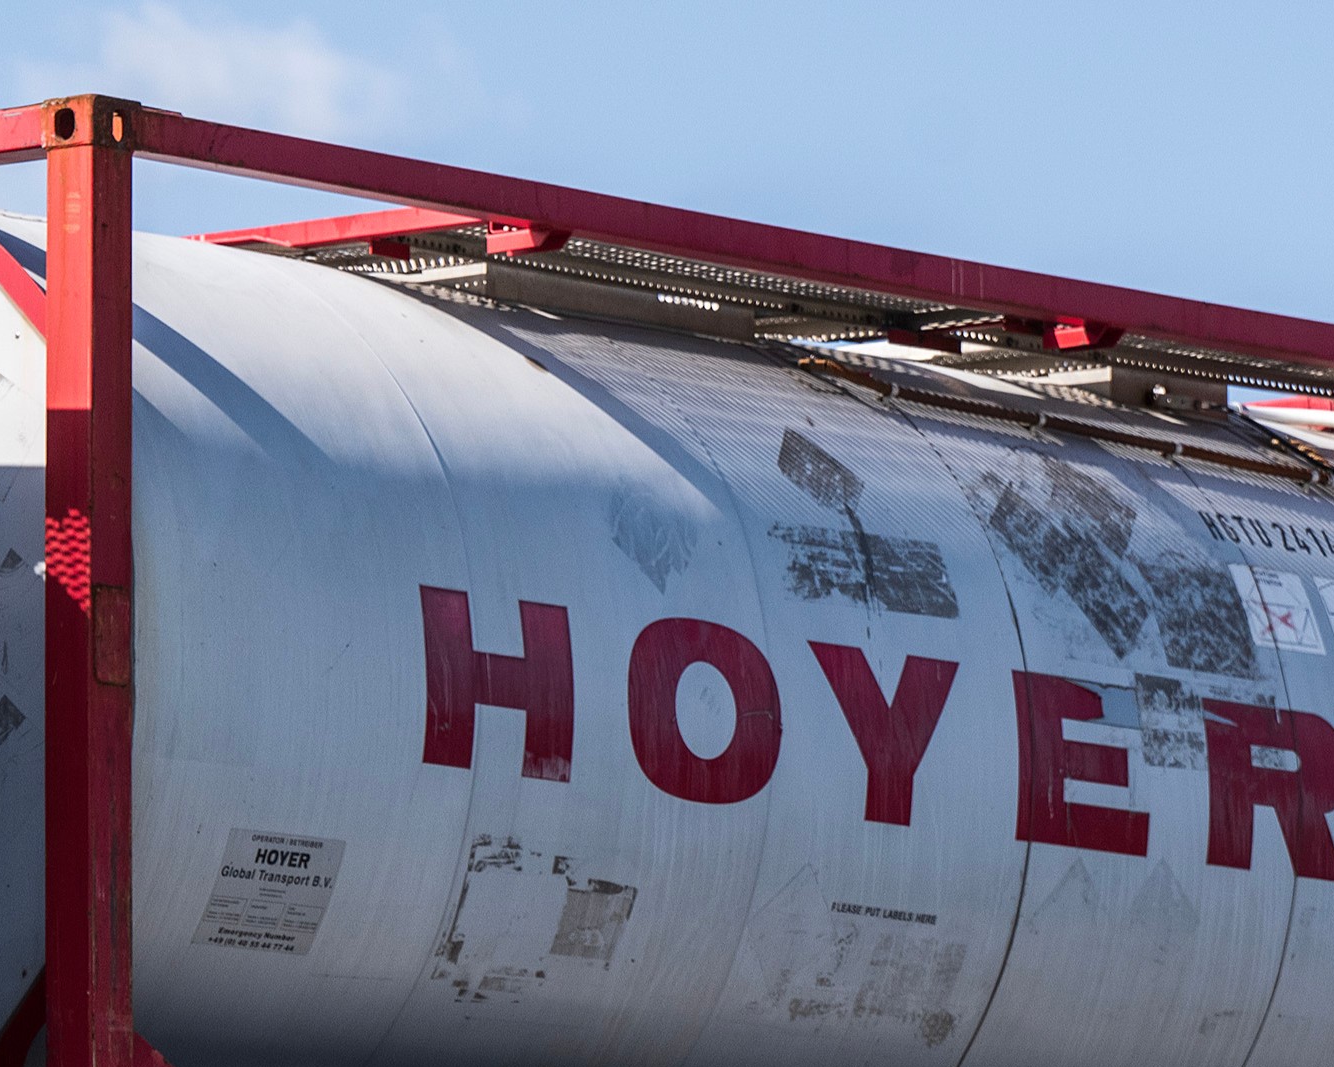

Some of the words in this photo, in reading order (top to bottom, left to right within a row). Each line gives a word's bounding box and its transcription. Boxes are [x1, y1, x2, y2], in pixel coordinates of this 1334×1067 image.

[1198, 511, 1273, 548] HGTU
[255, 848, 311, 870] HOYER
[221, 865, 256, 880] Global
[259, 870, 309, 887] Transport
[312, 875, 333, 889] B.V.
[831, 901, 862, 915] PLEASE
[865, 906, 881, 917] PUT
[883, 909, 914, 922] LABELS
[915, 913, 937, 925] HERE
[218, 927, 262, 940] Emergency
